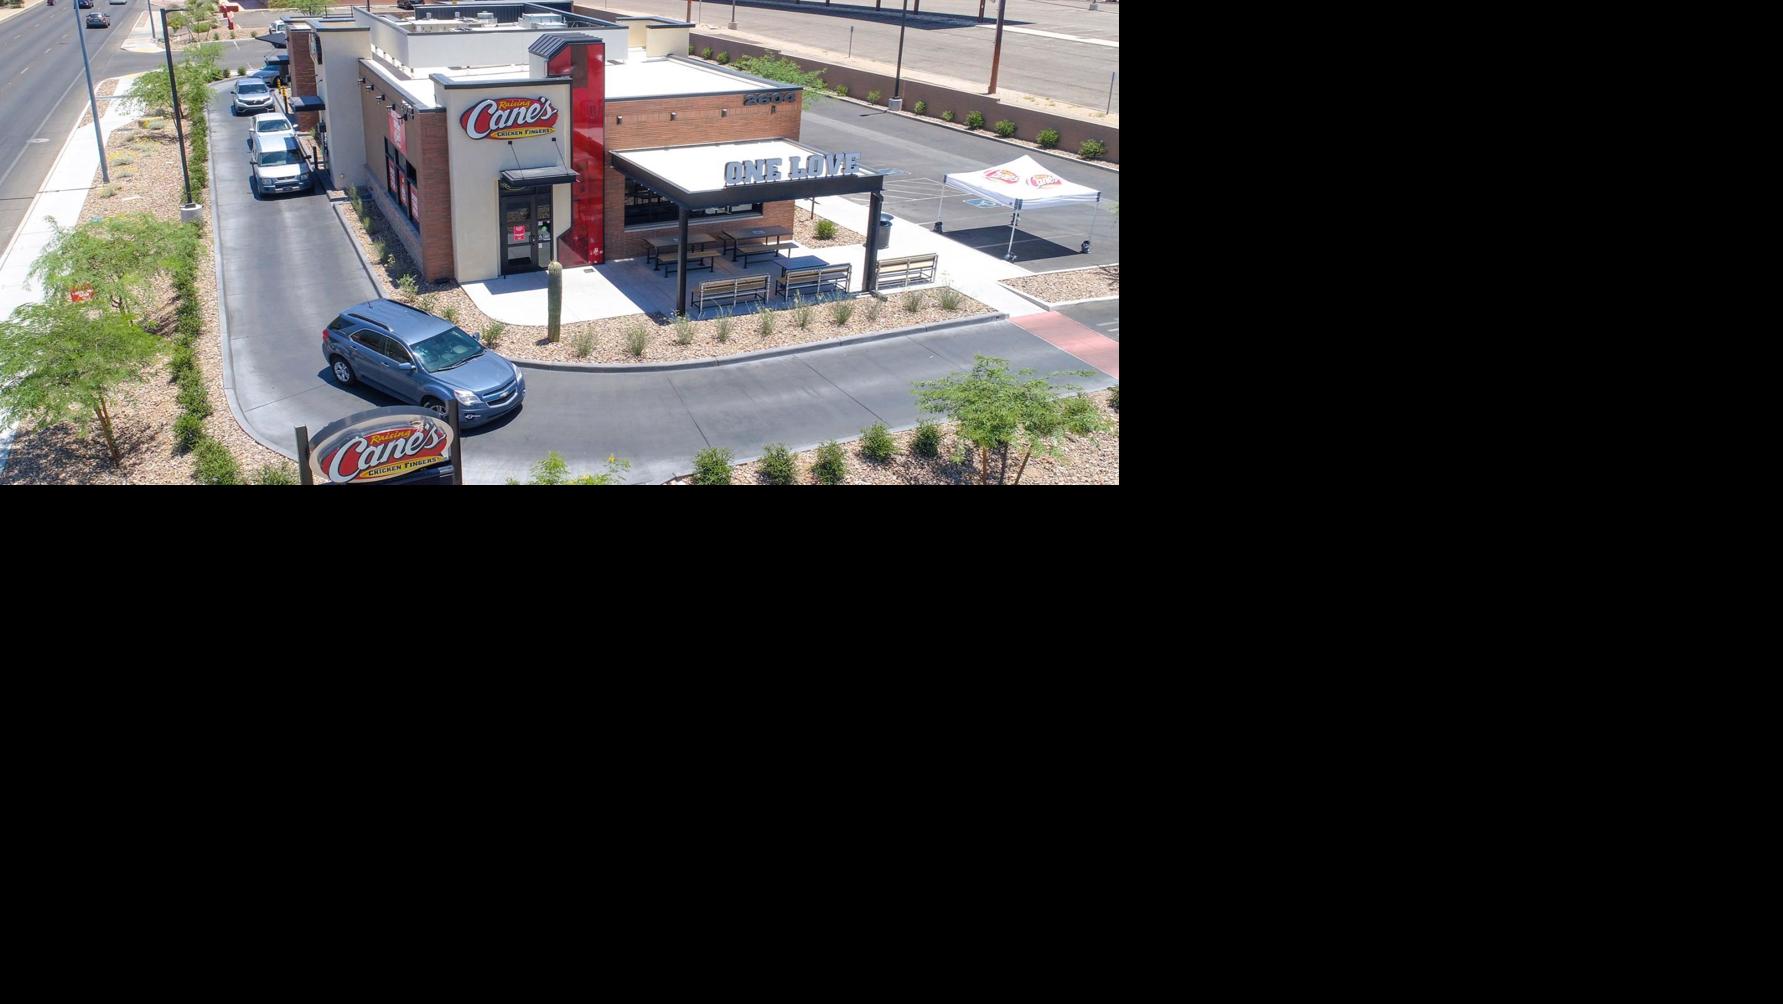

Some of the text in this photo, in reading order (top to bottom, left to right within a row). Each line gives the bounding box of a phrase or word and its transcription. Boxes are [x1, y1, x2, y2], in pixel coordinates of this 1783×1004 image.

[500, 100, 531, 109] Raising
[466, 97, 557, 139] Cane's
[724, 152, 862, 185] ONE LOVE
[371, 430, 411, 444] Raising
[329, 423, 447, 484] Cane's
[368, 458, 436, 476] CHICKEN FINGERS
